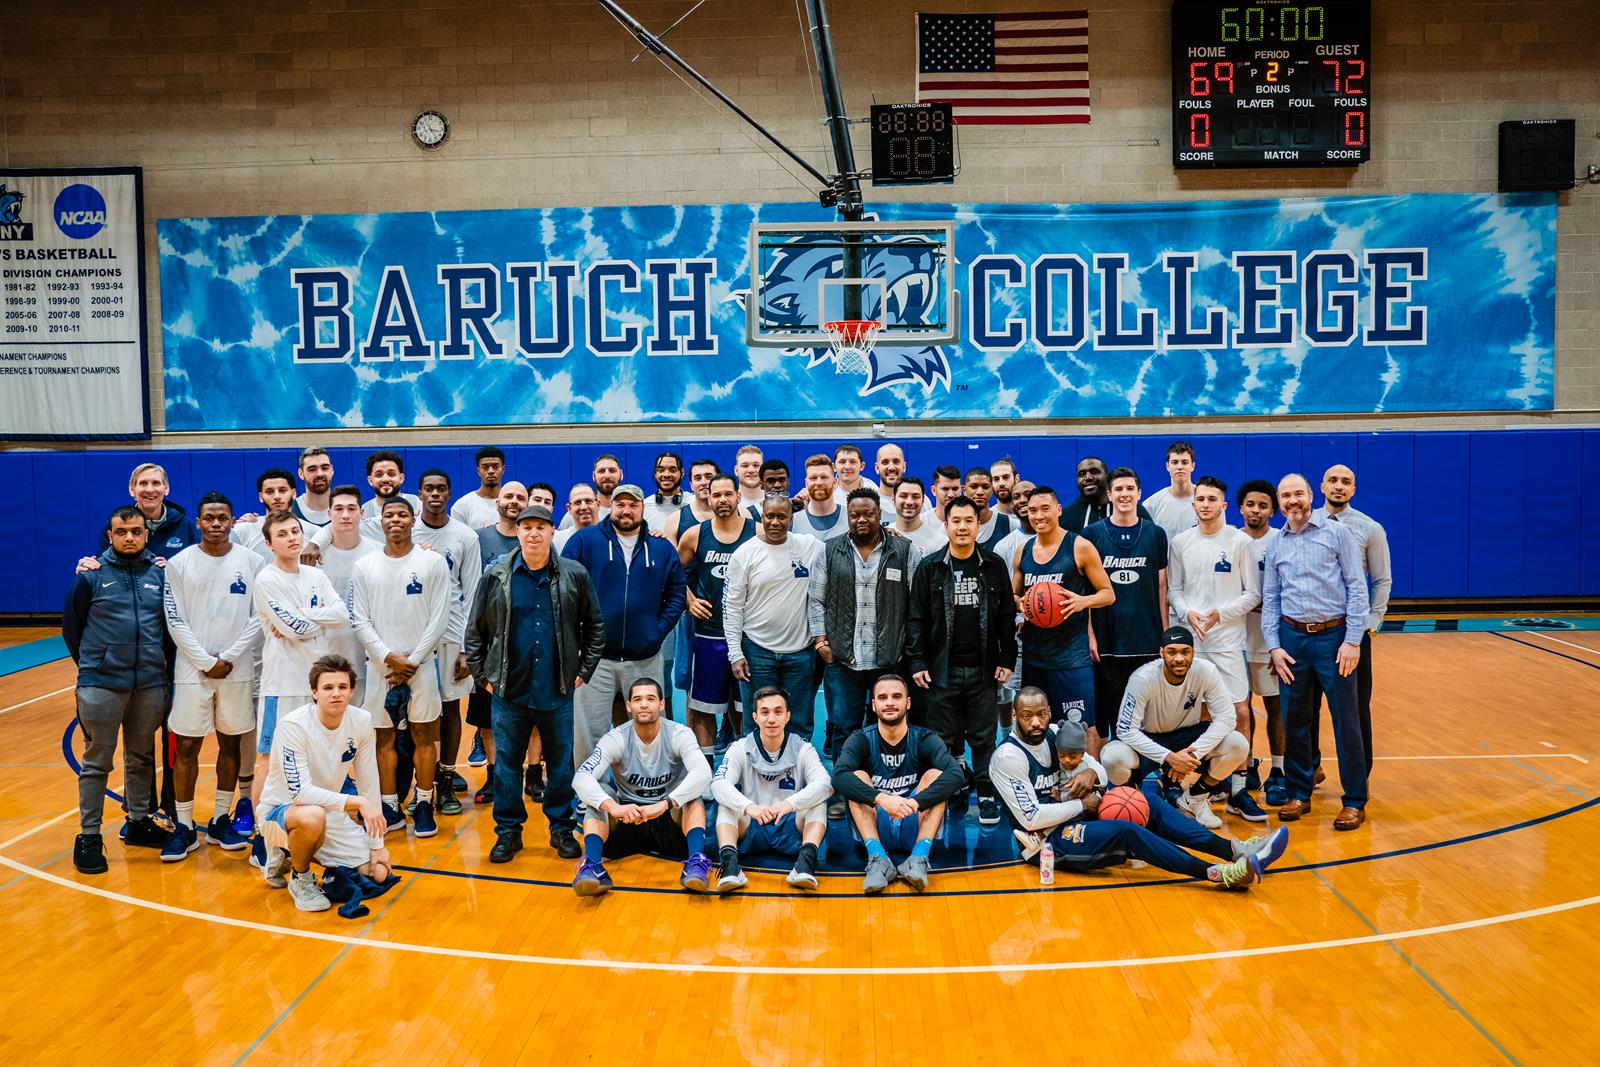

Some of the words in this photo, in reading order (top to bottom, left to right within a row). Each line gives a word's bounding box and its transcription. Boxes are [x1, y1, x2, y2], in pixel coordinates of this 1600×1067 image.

[1221, 7, 1324, 41] 60:00
[1188, 47, 1226, 58] HOME
[1254, 50, 1290, 59] PERIOD
[1315, 45, 1360, 56] GUEST
[1250, 68, 1258, 77] P
[1266, 61, 1279, 82] 2
[1287, 68, 1295, 76] P
[1190, 62, 1234, 96] 69
[1322, 60, 1365, 94] 72
[1255, 85, 1290, 94] BONUS
[1179, 100, 1212, 109] FOULS
[1237, 99, 1274, 108] PLAYER
[1288, 98, 1315, 107] FOUL
[1334, 98, 1367, 107] FOULS
[1190, 113, 1210, 148] 0
[1345, 111, 1364, 145] 0
[1179, 152, 1214, 161] SCORE
[1264, 151, 1299, 160] MATCH
[1326, 150, 1361, 159] SCORE
[60, 210, 105, 225] NCAA
[16, 248, 117, 260] BASKETBALL
[3, 269, 52, 278] DIVISION
[55, 268, 122, 277] CHAMPIONS
[4, 283, 36, 291] 1981-82
[47, 283, 80, 291] 1992-93
[90, 282, 124, 290] 1993-94
[47, 297, 80, 305] 1999-00
[91, 296, 124, 304] 2000-01
[968, 247, 1428, 352] COLLEGE
[5, 311, 37, 319] 2005-06
[48, 311, 80, 319] 2007-08
[91, 310, 124, 318] 2008-09
[290, 257, 718, 364] BARUCH
[6, 325, 38, 333] 2009-10
[49, 325, 80, 333] 2010-11
[28, 367, 33, 375] &
[81, 366, 120, 374] CHAMPIONS
[1120, 571, 1130, 581] 81
